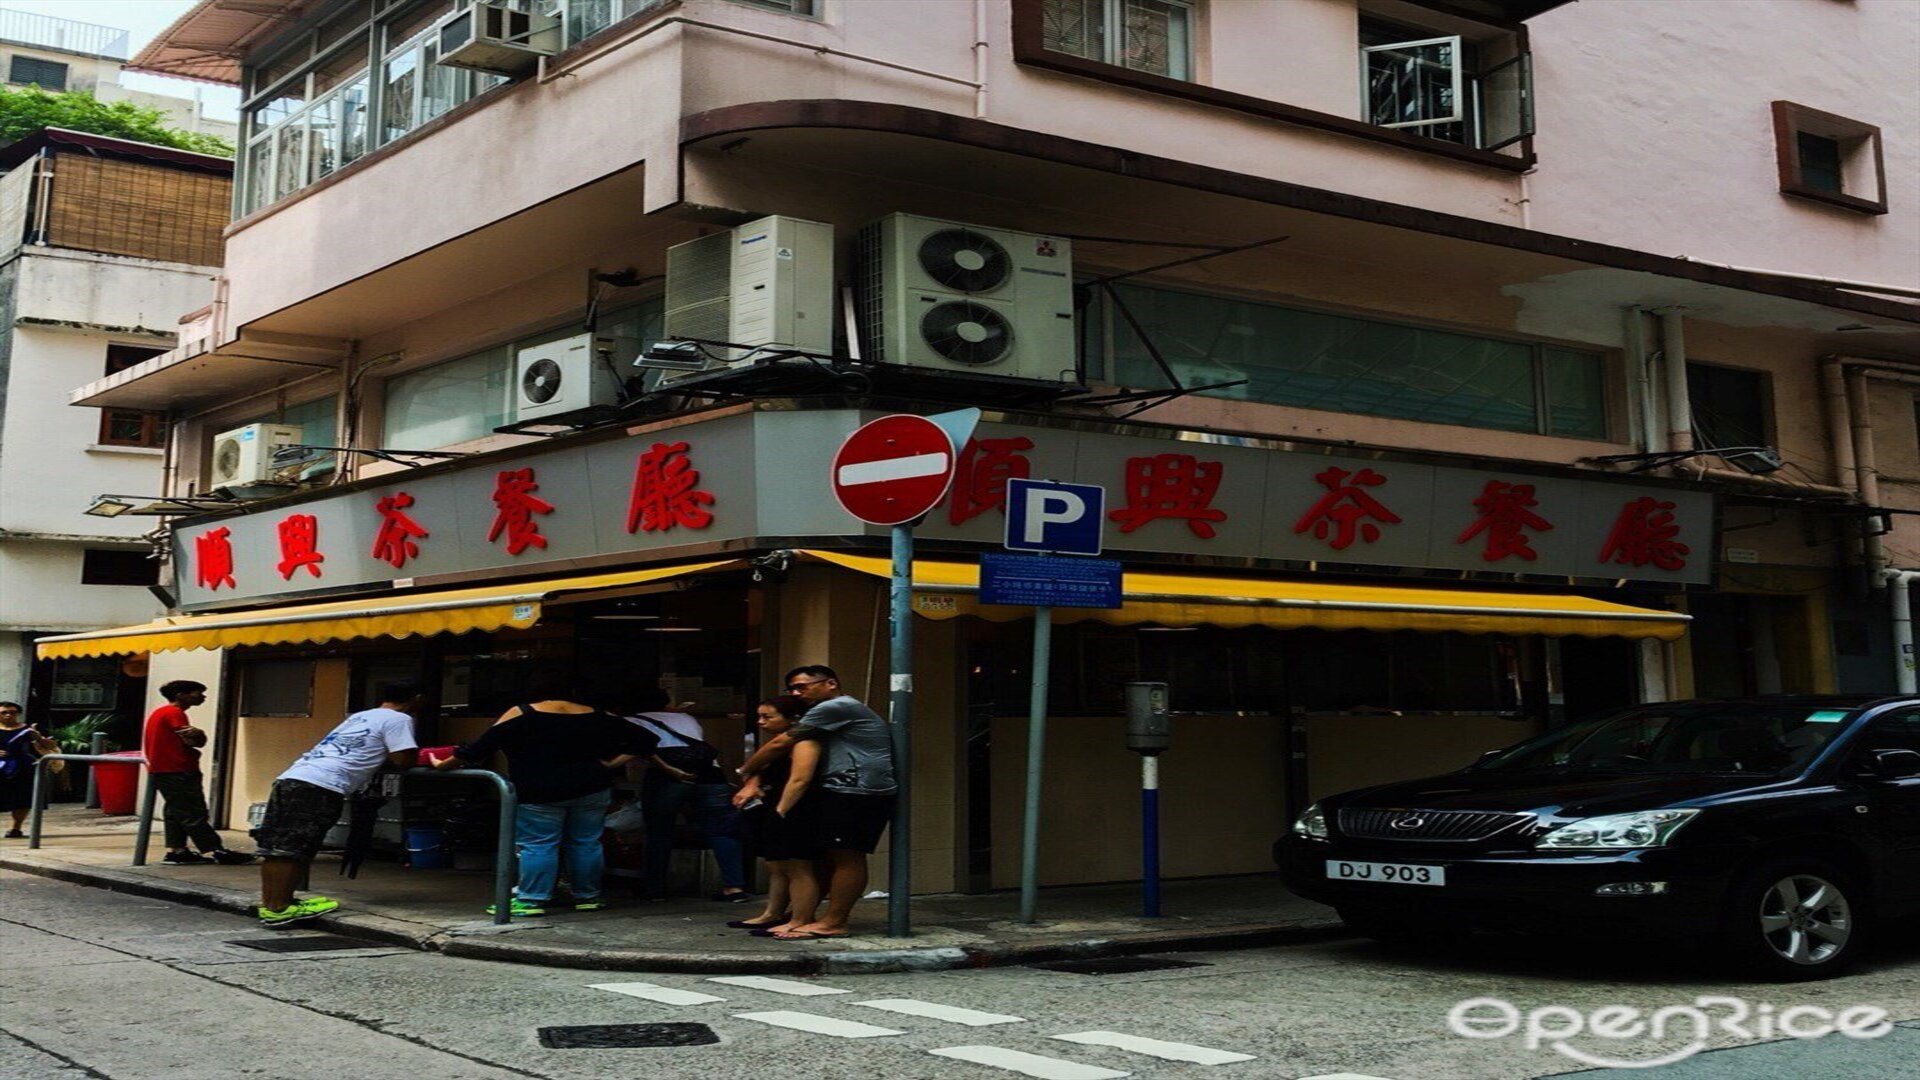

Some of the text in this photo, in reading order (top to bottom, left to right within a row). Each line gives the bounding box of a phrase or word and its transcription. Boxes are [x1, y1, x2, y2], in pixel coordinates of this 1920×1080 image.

[195, 441, 715, 593] 順興茶餐廳
[1024, 487, 1086, 544] P
[1339, 862, 1431, 883] DJ 903
